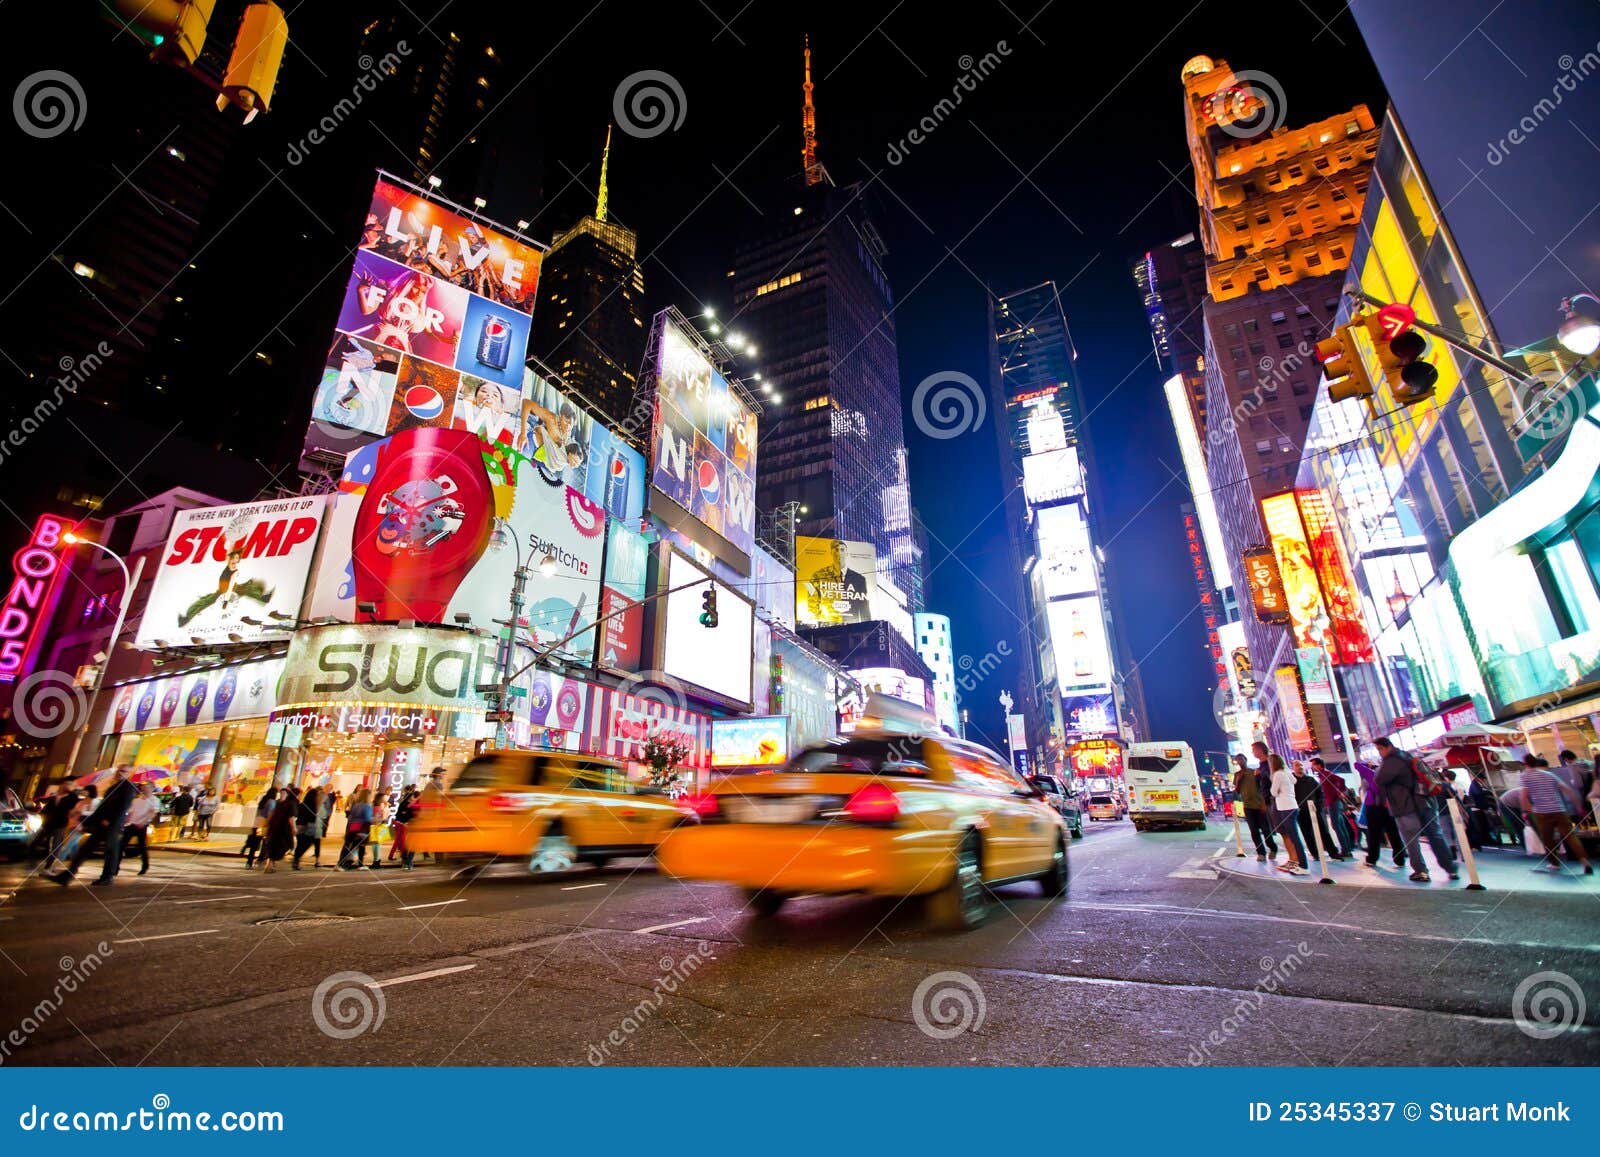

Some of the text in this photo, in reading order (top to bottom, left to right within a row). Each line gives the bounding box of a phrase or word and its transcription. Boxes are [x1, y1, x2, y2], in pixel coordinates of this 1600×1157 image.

[385, 207, 525, 290] LIVE
[367, 285, 444, 333] FOR
[188, 500, 314, 521] WHERE NEW YORK TURNS IT UP
[166, 517, 318, 567] STOMP
[820, 581, 856, 592] HIRE A
[820, 590, 868, 600] VETERAN
[347, 712, 423, 730] swatch
[614, 710, 648, 742] Foot
